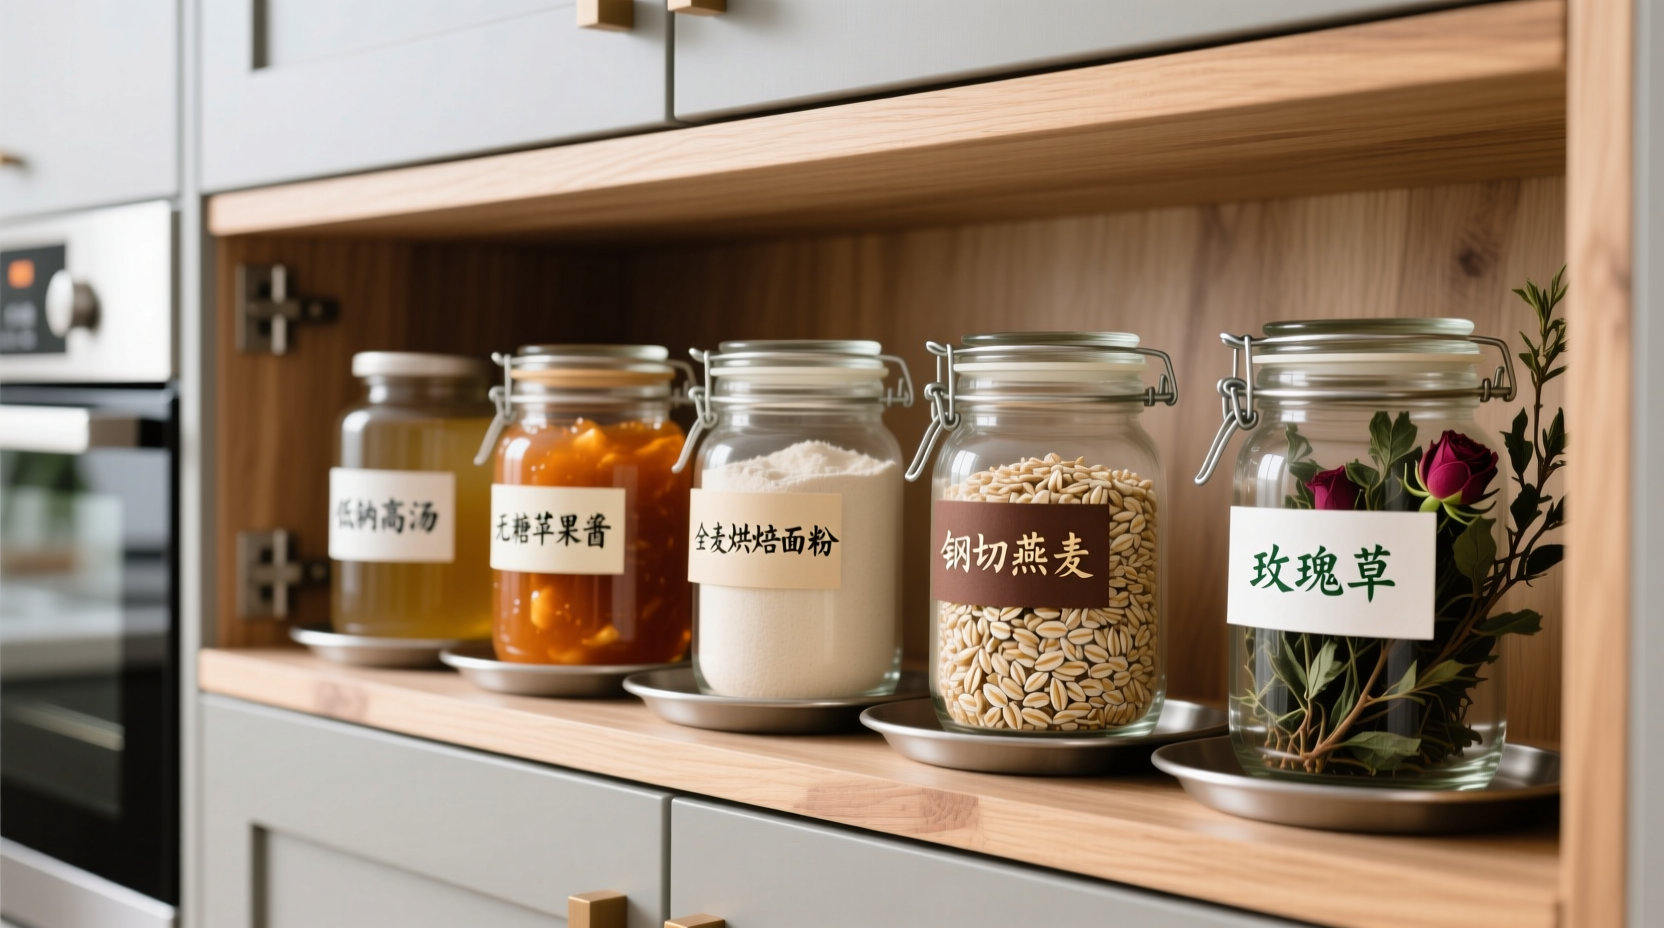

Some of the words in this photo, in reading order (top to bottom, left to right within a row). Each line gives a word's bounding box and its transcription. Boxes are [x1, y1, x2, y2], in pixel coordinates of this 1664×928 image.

[496, 511, 611, 548] 无糖苹果酱
[694, 521, 840, 557] 全麦烘焙面粉
[940, 529, 1094, 578] 钢切燕麦
[1250, 543, 1396, 603] 玫瑰草
